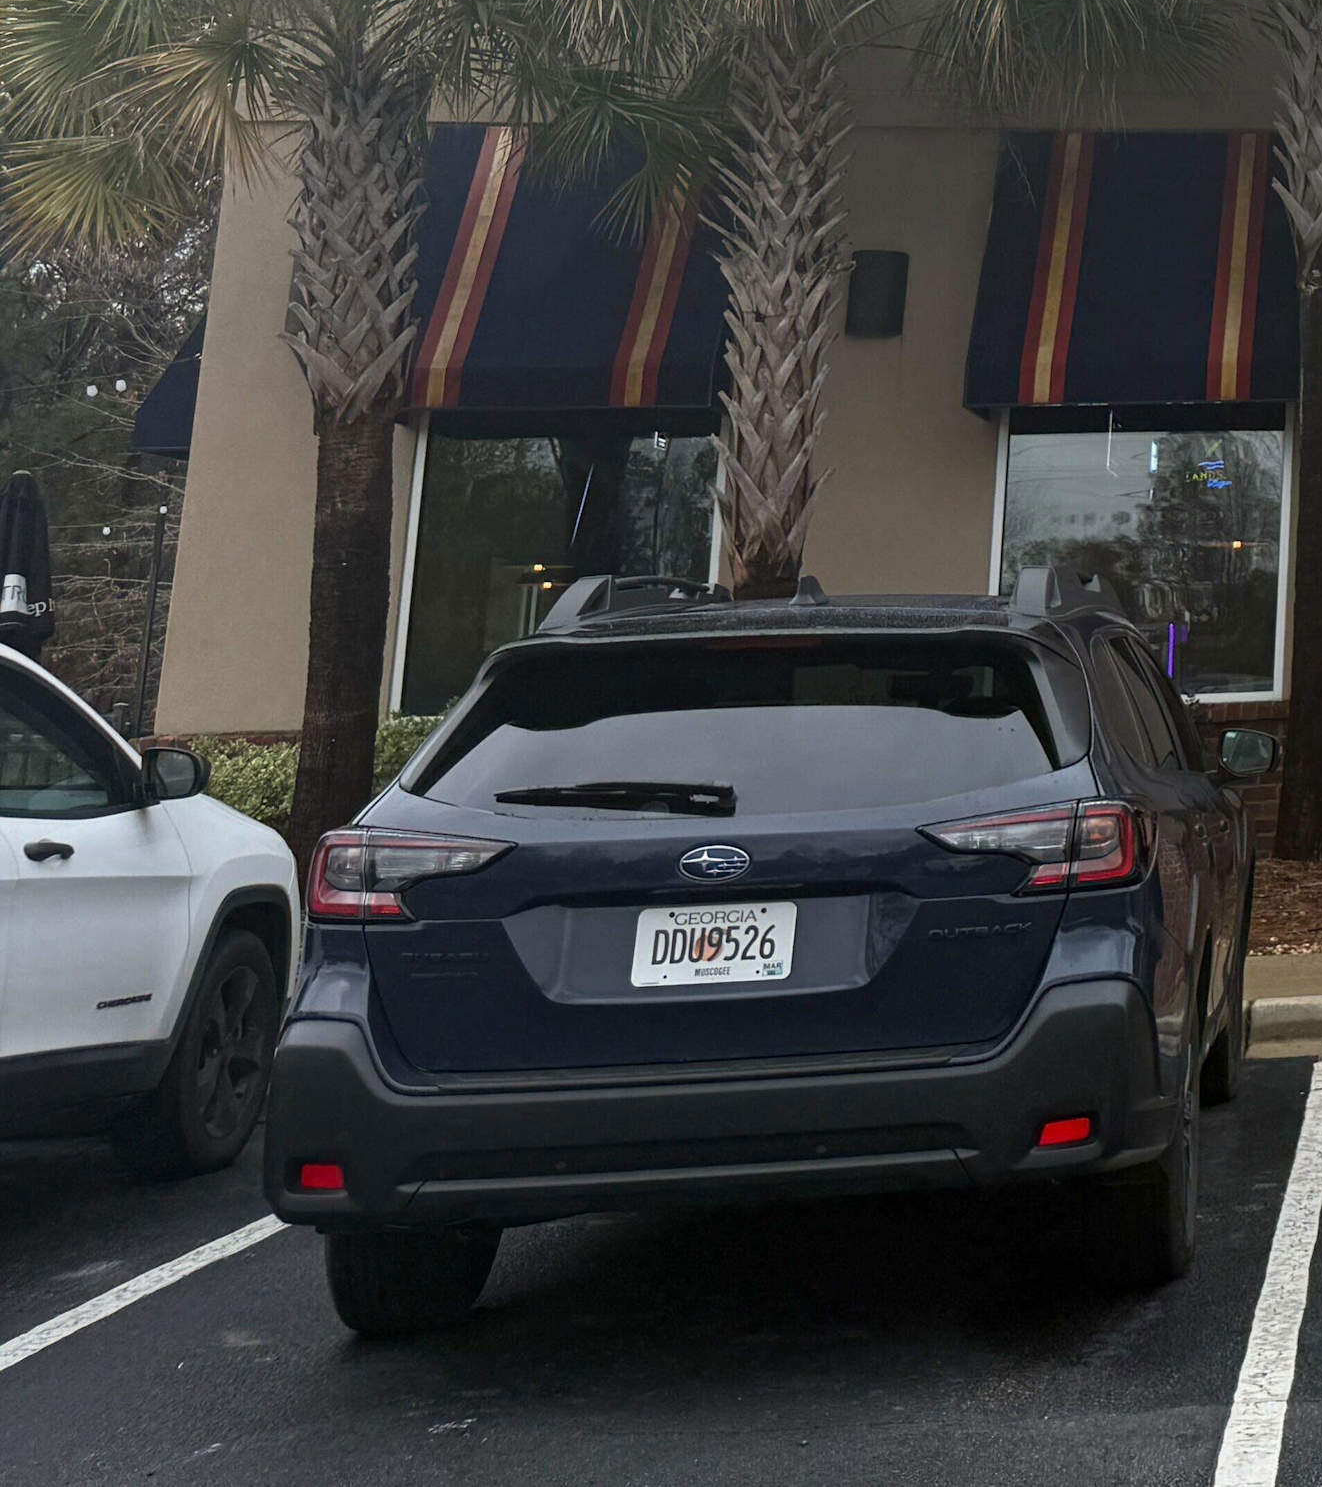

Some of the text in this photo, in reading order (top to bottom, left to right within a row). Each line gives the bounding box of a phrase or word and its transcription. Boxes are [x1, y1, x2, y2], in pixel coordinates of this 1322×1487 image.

[674, 909, 757, 926] GEORGIA
[928, 921, 1032, 939] OUTBACK
[651, 924, 776, 965] DDU9526
